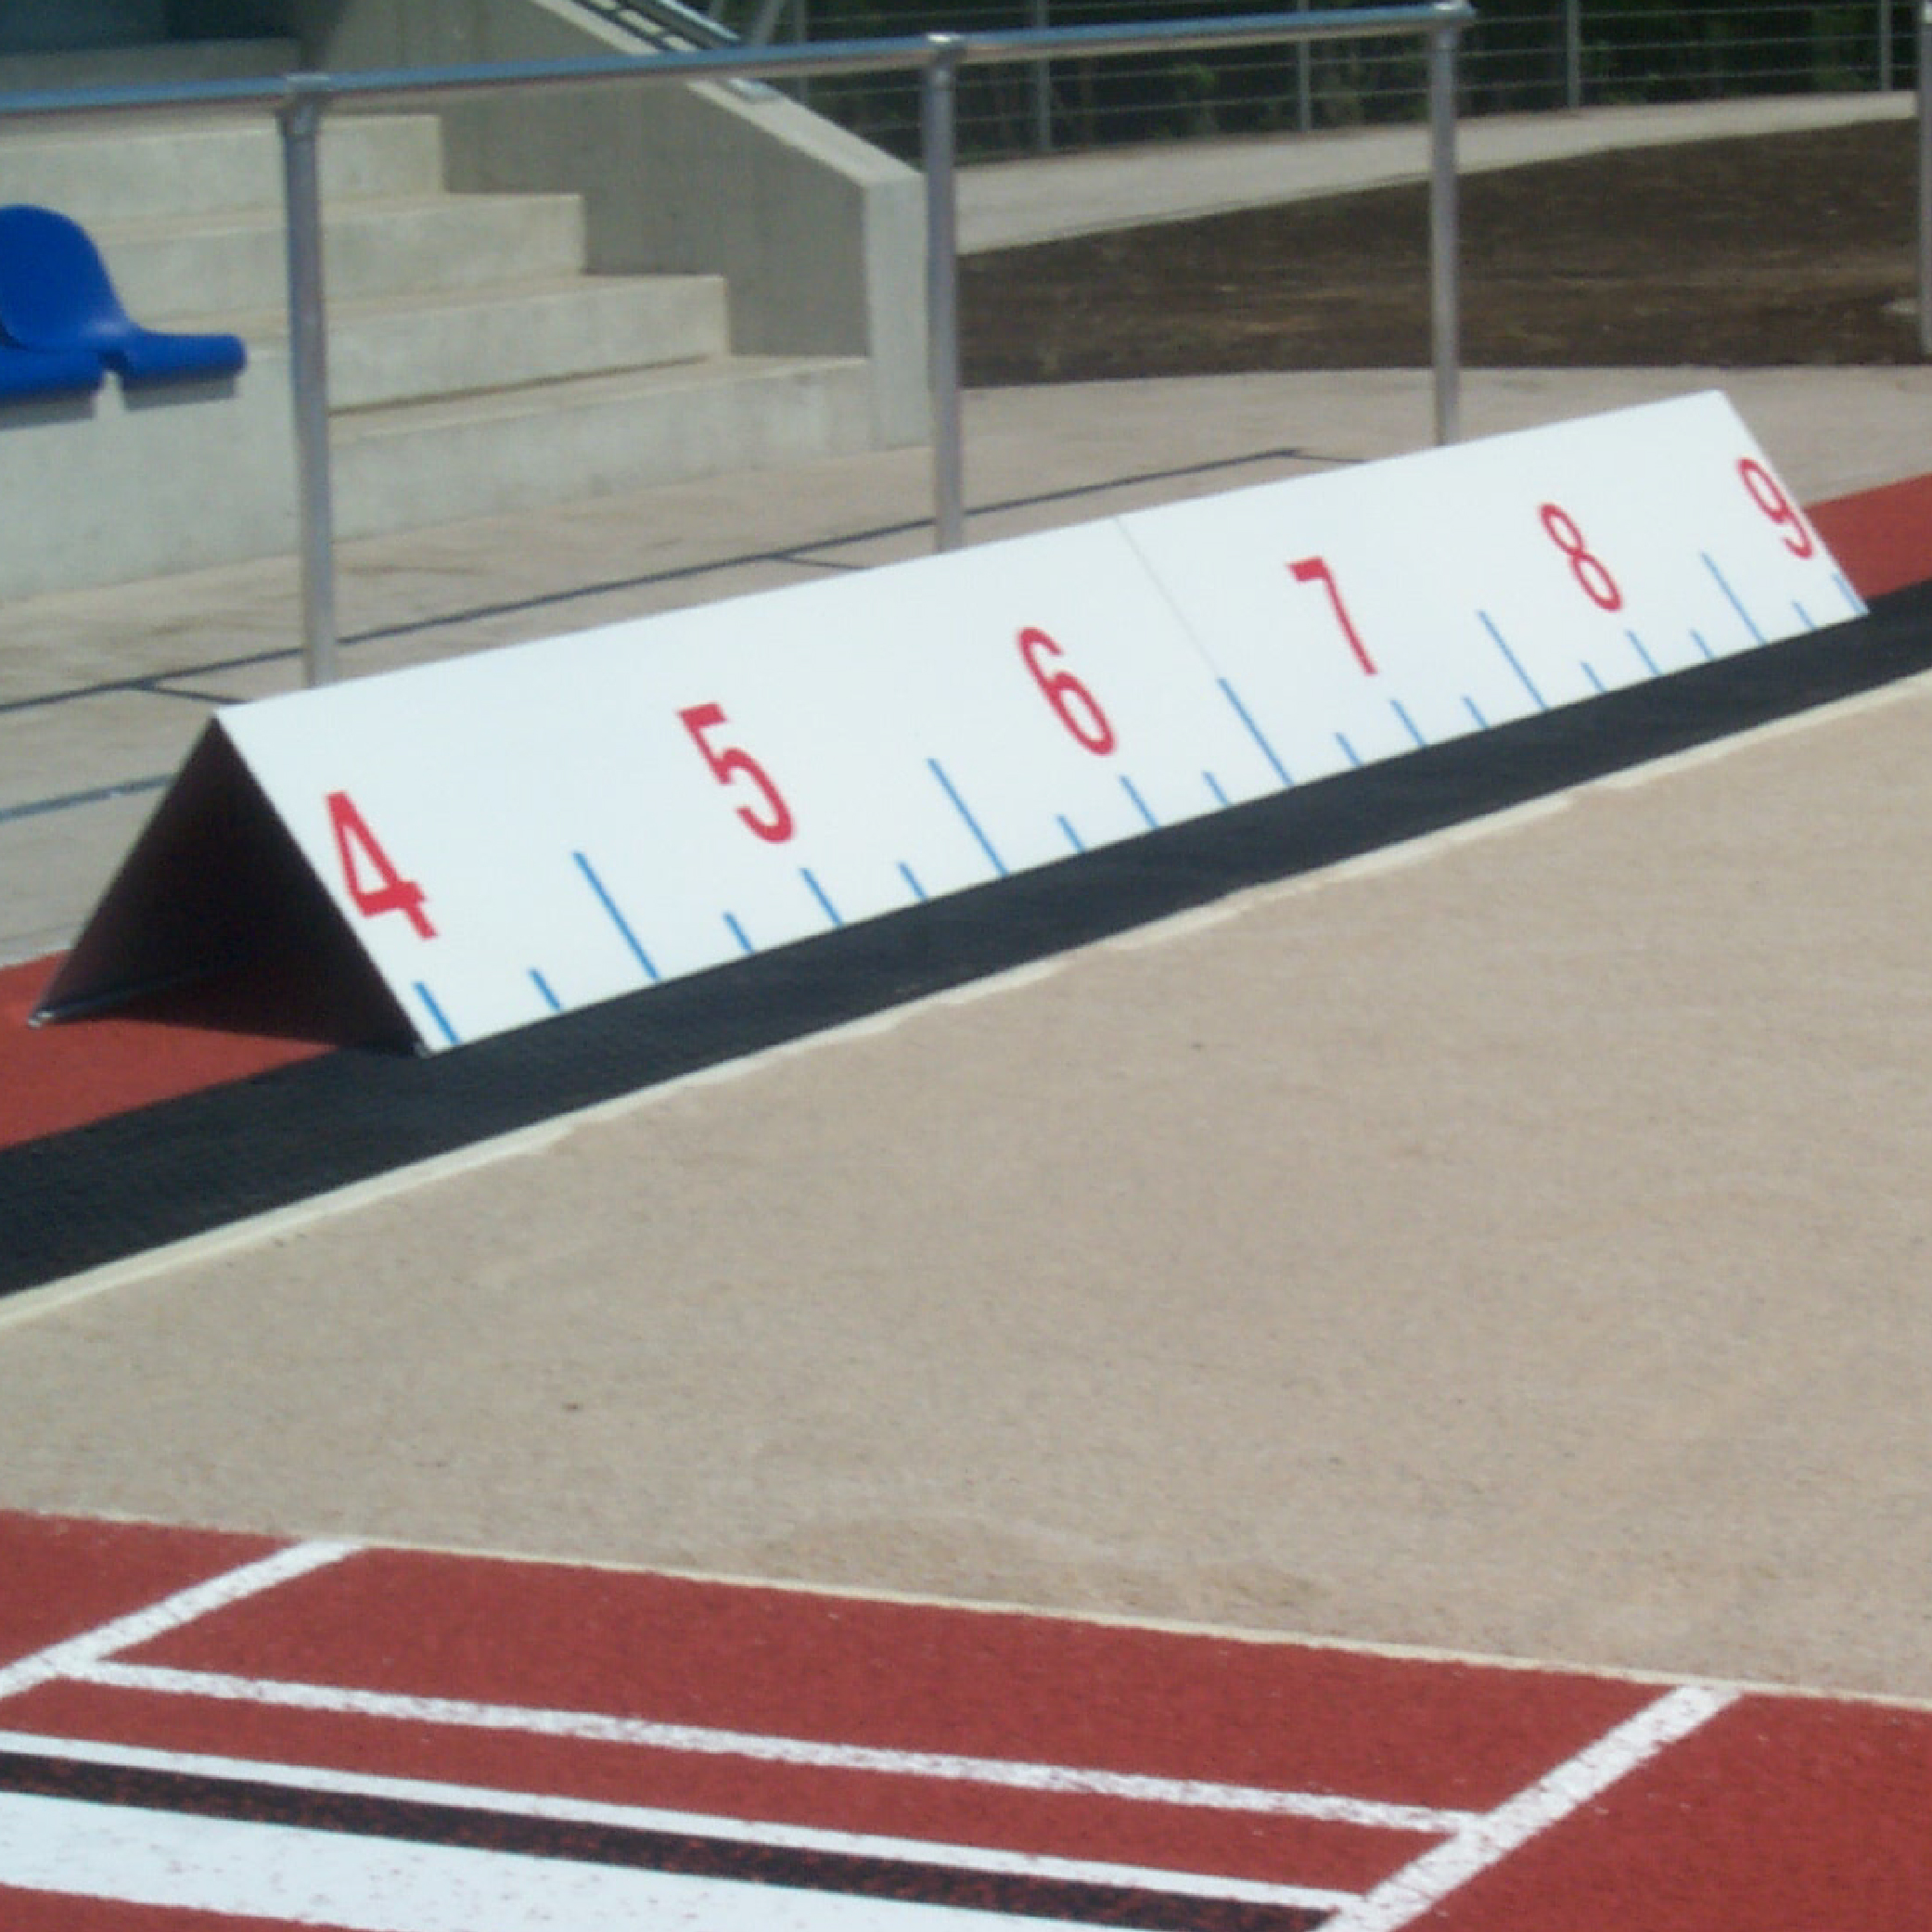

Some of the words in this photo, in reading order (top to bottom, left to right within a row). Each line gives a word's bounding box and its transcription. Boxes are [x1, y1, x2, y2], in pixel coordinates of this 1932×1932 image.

[326, 792, 437, 940] 4
[677, 703, 795, 844] 5
[1017, 626, 1115, 757] 6
[1288, 557, 1375, 675] 7
[1539, 504, 1623, 611] 8
[1736, 458, 1814, 559] 9
